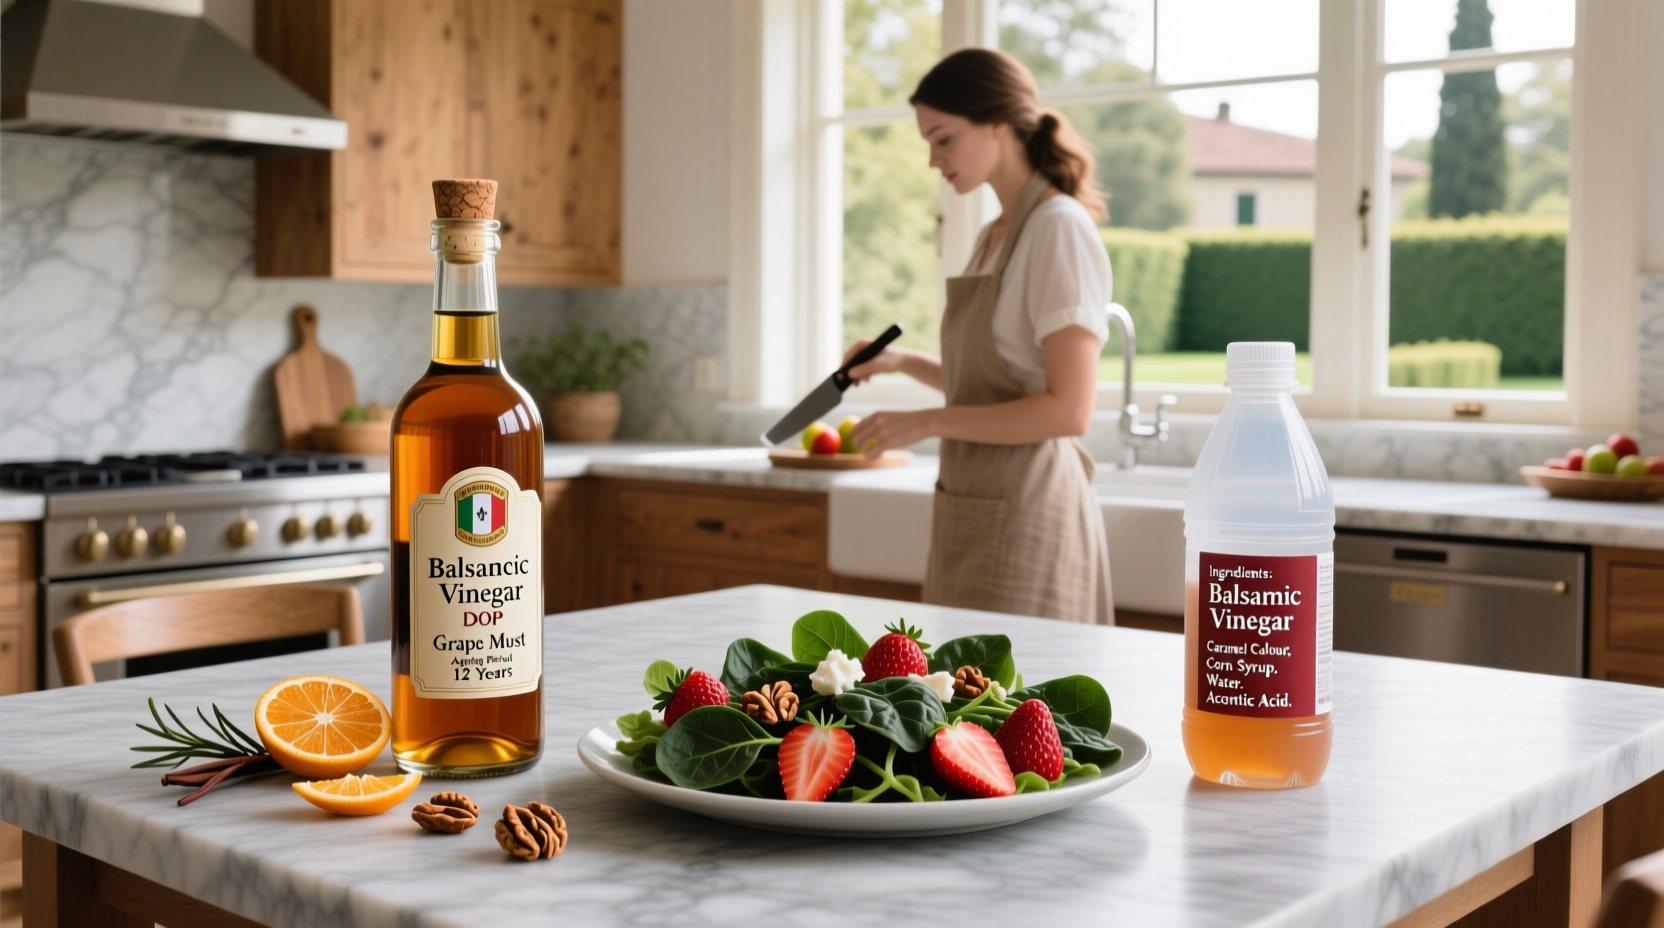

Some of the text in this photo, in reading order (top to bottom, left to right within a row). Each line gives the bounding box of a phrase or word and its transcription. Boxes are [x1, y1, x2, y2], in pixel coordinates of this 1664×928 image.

[428, 555, 529, 579] Balsancic
[438, 583, 523, 608] Vinegar
[1209, 583, 1302, 605] Balsamic
[463, 611, 503, 627] DOP
[1209, 607, 1294, 636] Vinegar
[433, 632, 526, 655] Grape Must
[454, 667, 513, 681] 12 Years
[1206, 657, 1278, 678] Corn Syrup.
[1206, 673, 1244, 690] Water.
[1258, 693, 1292, 708] Acid.
